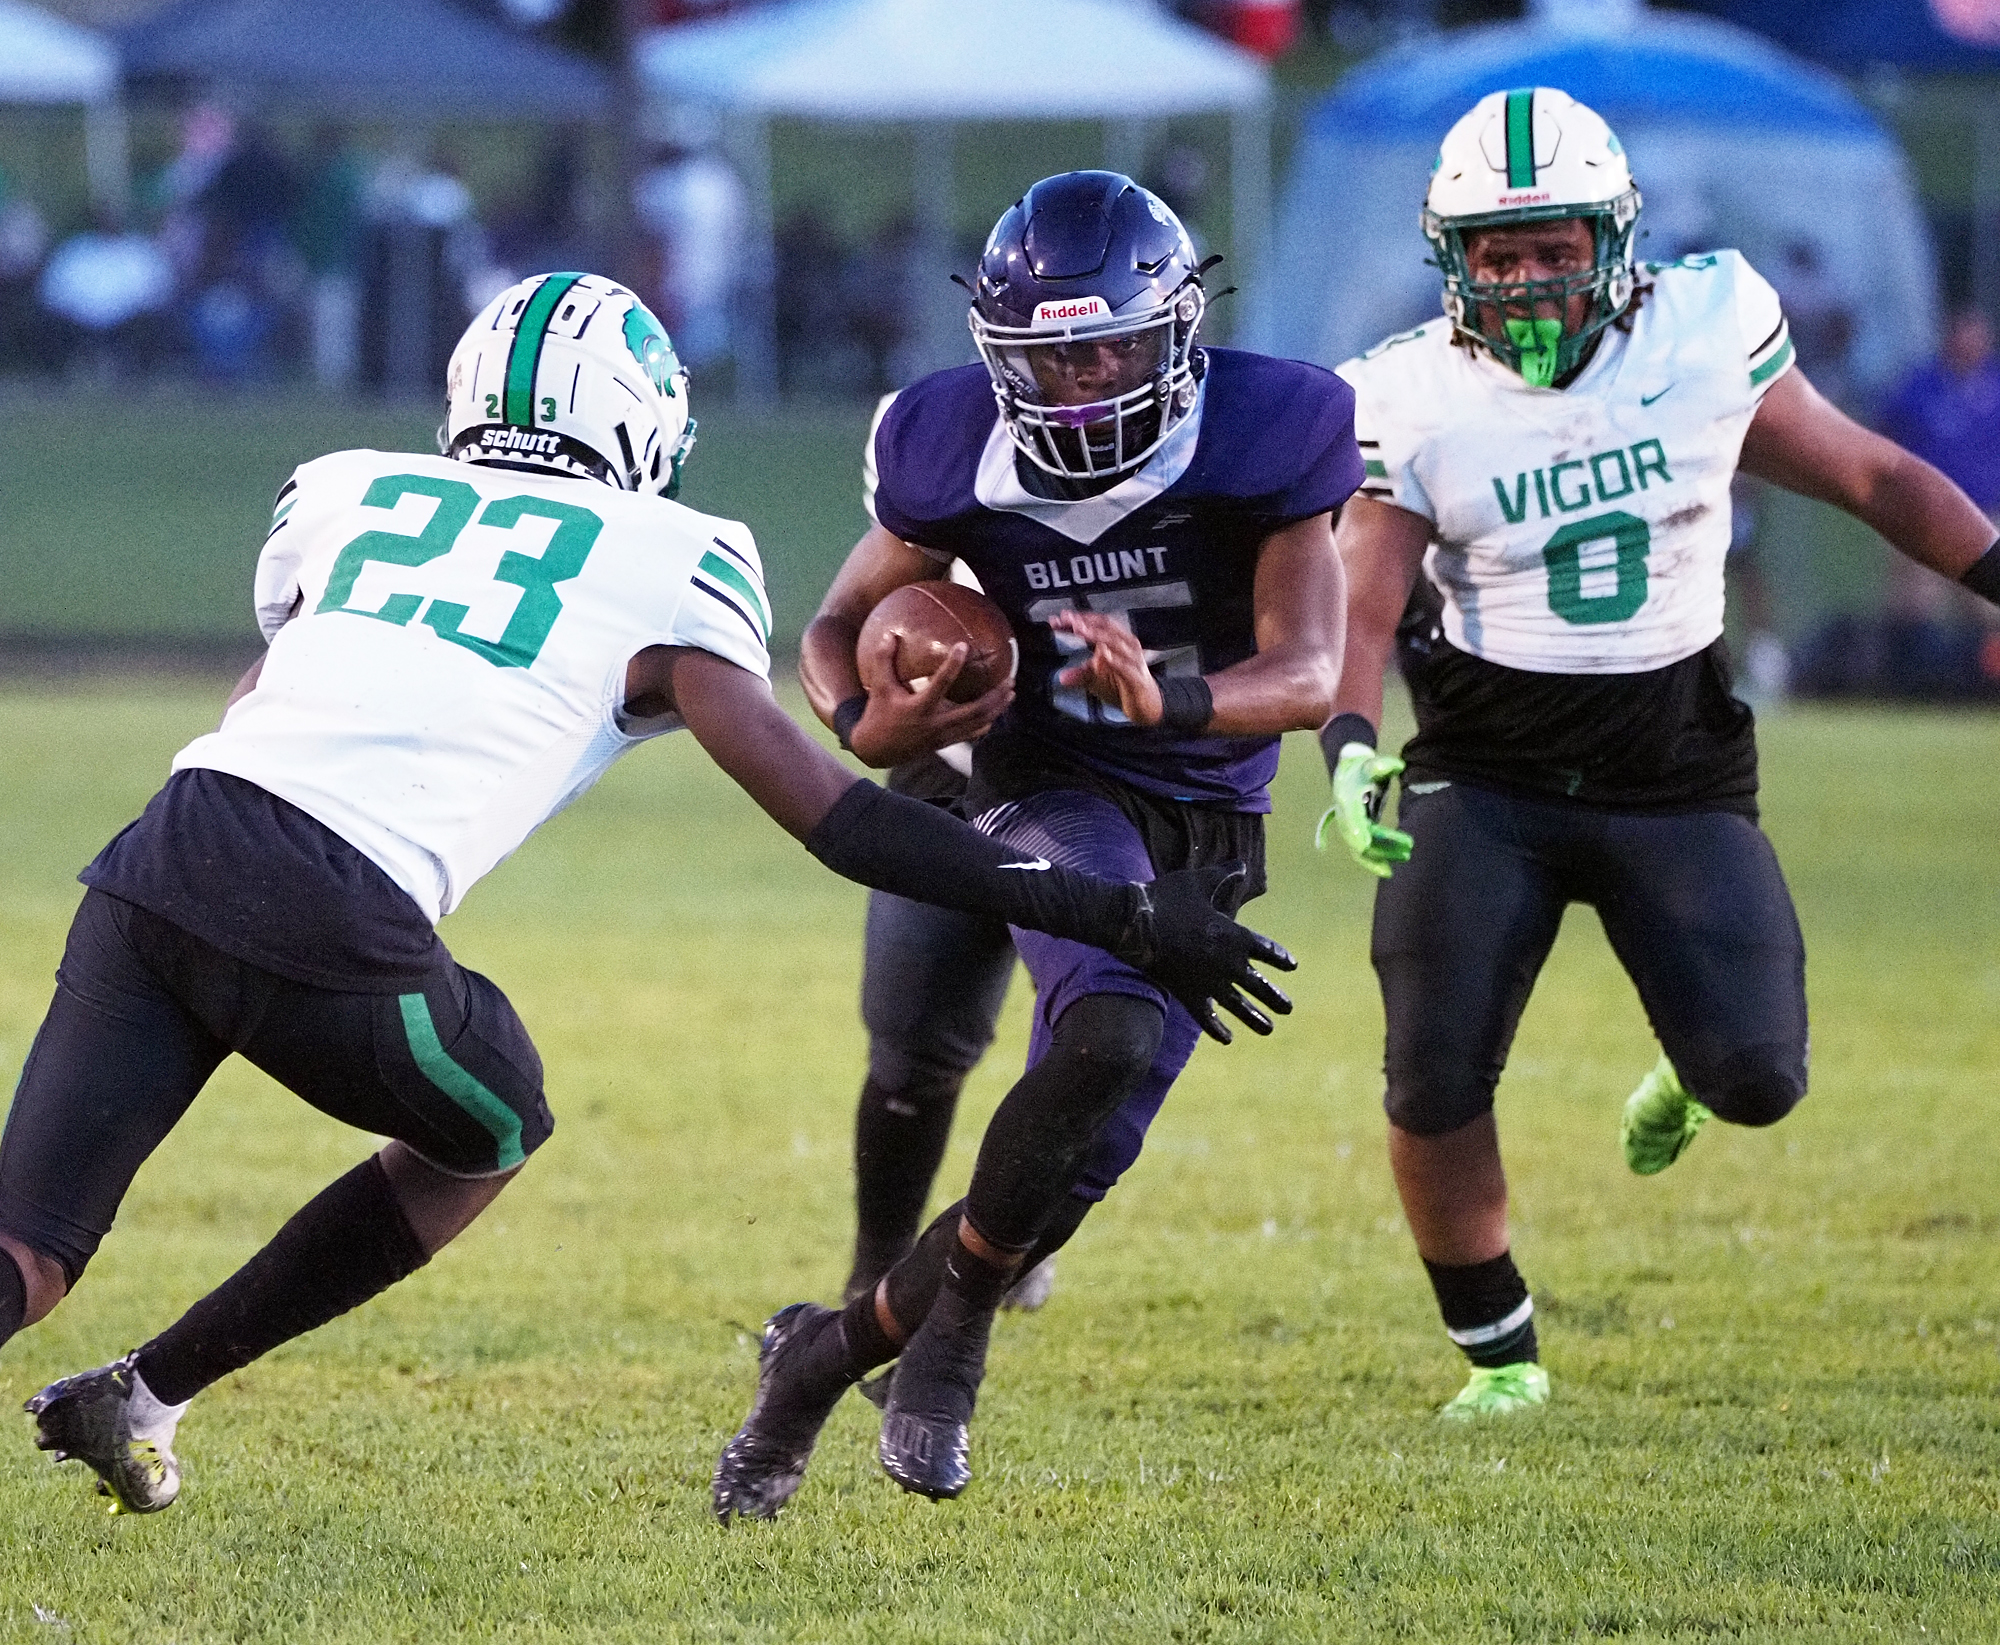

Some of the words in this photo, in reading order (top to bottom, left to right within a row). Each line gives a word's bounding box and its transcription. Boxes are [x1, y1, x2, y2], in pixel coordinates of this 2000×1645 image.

[1040, 301, 1099, 320] Riddell
[480, 426, 561, 454] schutt
[1492, 437, 1674, 524] VIGOR
[313, 473, 605, 669] 23
[1023, 546, 1168, 590] BLOUNT
